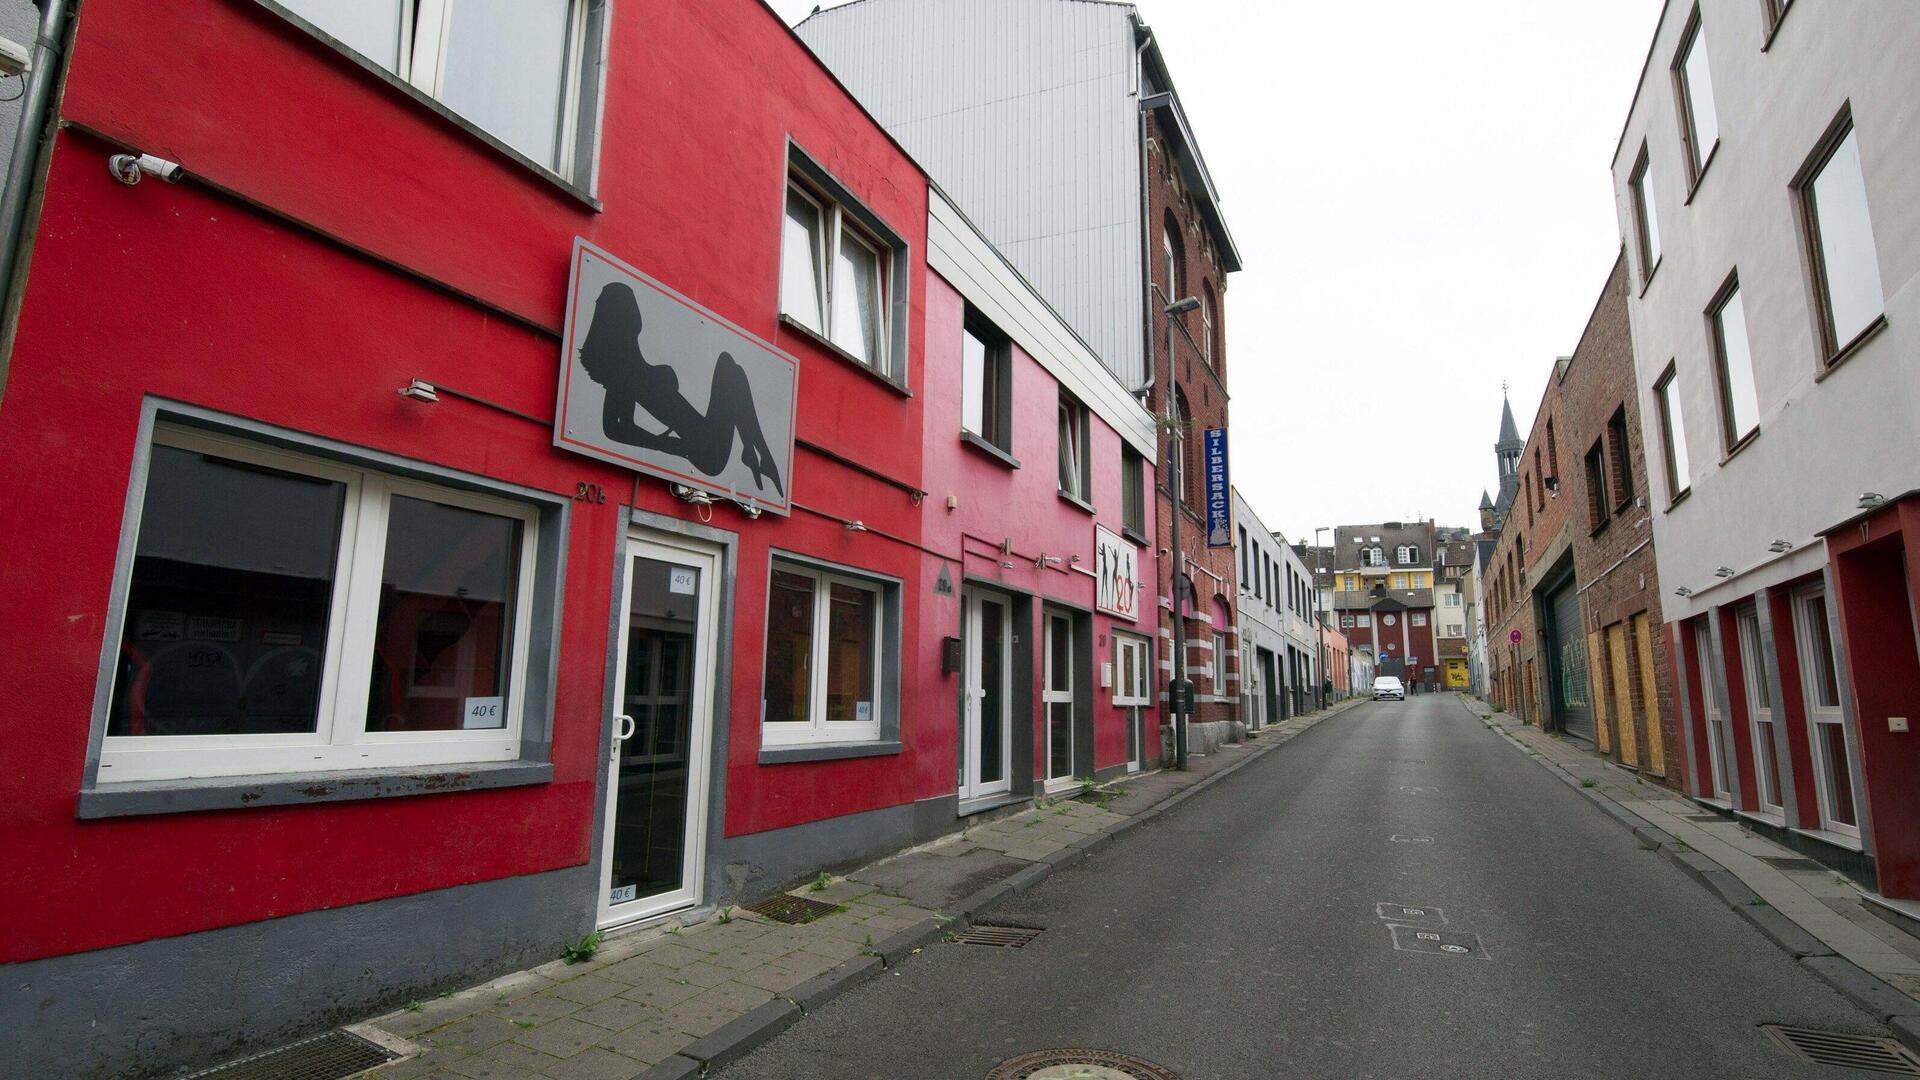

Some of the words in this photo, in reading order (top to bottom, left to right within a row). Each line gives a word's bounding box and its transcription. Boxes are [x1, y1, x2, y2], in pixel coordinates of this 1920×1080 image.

[1210, 430, 1225, 518] SILBERSACK
[575, 480, 605, 504] 20b
[674, 575, 685, 585] 40
[1115, 574, 1133, 613] 20
[471, 705, 487, 717] 40
[489, 705, 497, 717] €
[610, 889, 623, 901] 40
[624, 887, 631, 898] €
